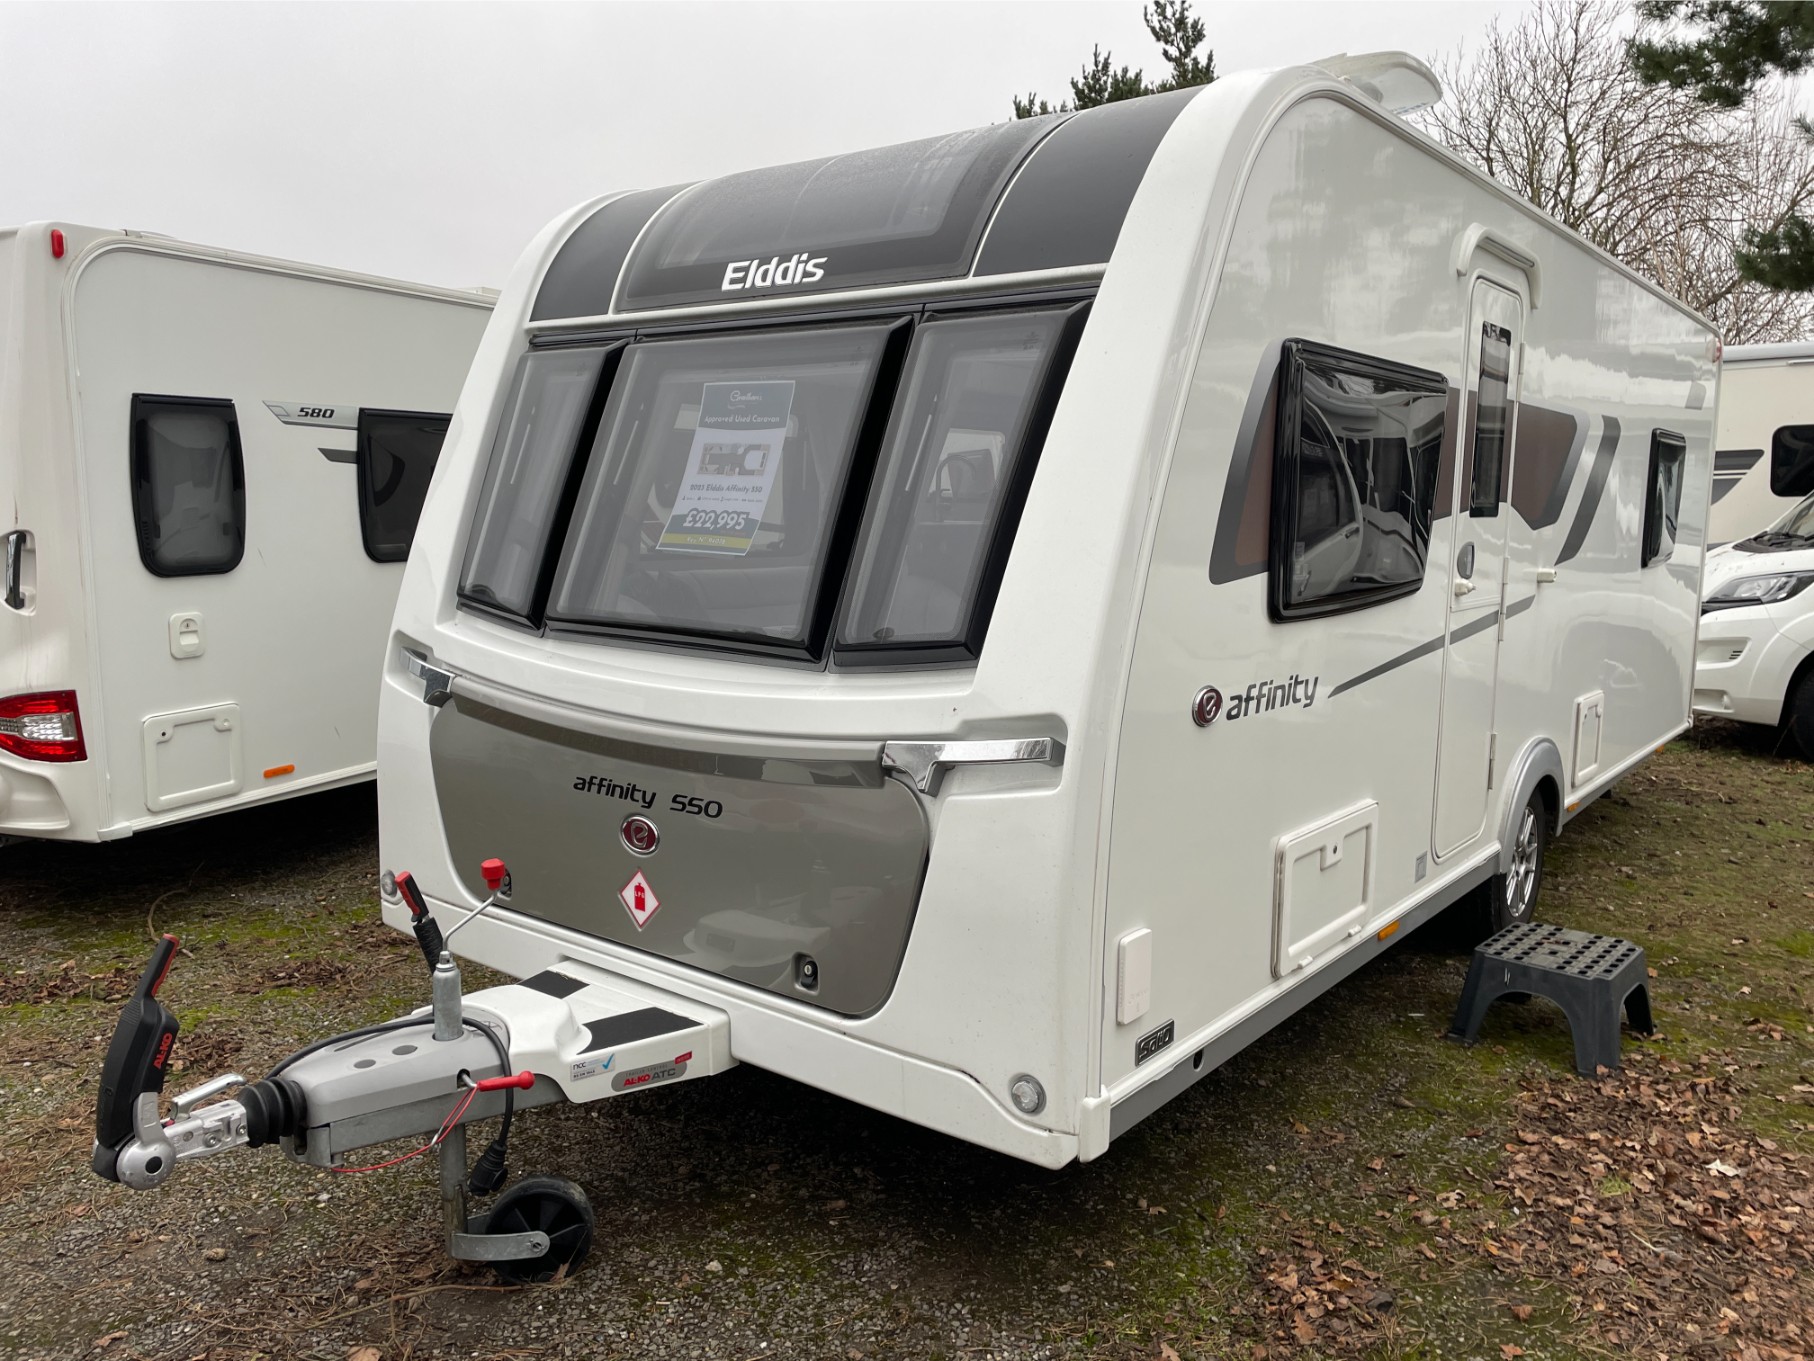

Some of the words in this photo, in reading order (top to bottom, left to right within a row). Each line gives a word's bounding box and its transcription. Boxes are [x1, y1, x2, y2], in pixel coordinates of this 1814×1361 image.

[721, 252, 828, 292] Elddis
[297, 406, 335, 419] 580
[704, 414, 734, 424] Approved
[734, 414, 751, 423] Used
[752, 414, 780, 423] Caravan
[705, 484, 724, 492] Elddis
[725, 484, 749, 494] Affinity
[682, 509, 747, 530] £22,995
[1226, 674, 1319, 721] affinity
[573, 775, 657, 810] affinity
[669, 793, 724, 819] 550
[634, 890, 646, 899] LPG
[572, 1061, 587, 1071] ncc
[651, 1067, 676, 1081] ATC
